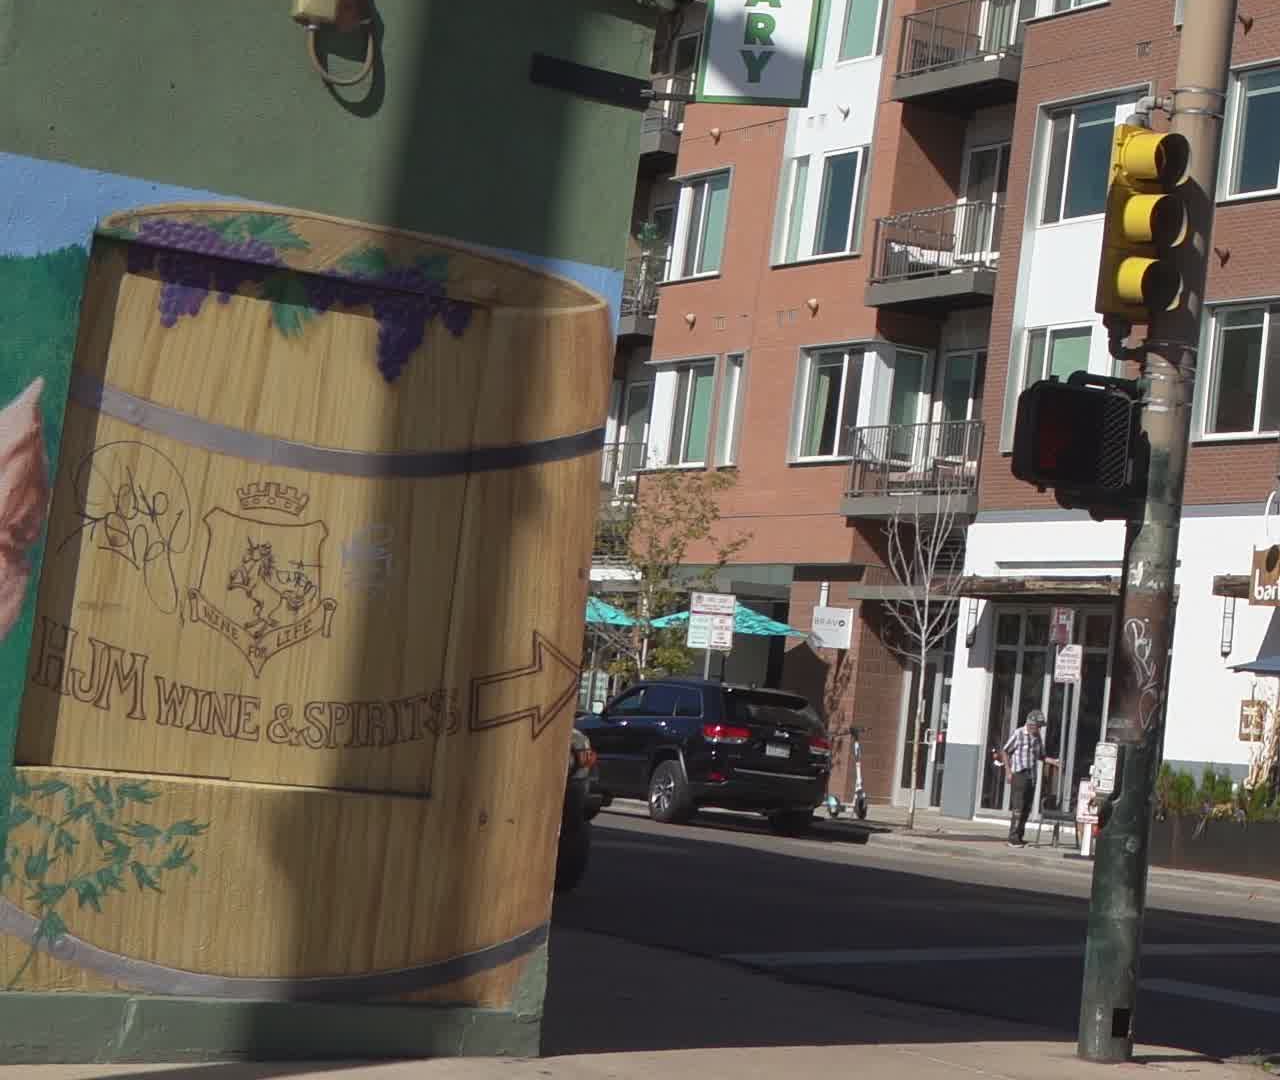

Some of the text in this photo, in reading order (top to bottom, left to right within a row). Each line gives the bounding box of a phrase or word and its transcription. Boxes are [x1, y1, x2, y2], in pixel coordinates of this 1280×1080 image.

[202, 605, 239, 640] WINE
[276, 618, 313, 648] LIFE
[32, 617, 151, 721] HJM
[154, 676, 262, 742] WINE
